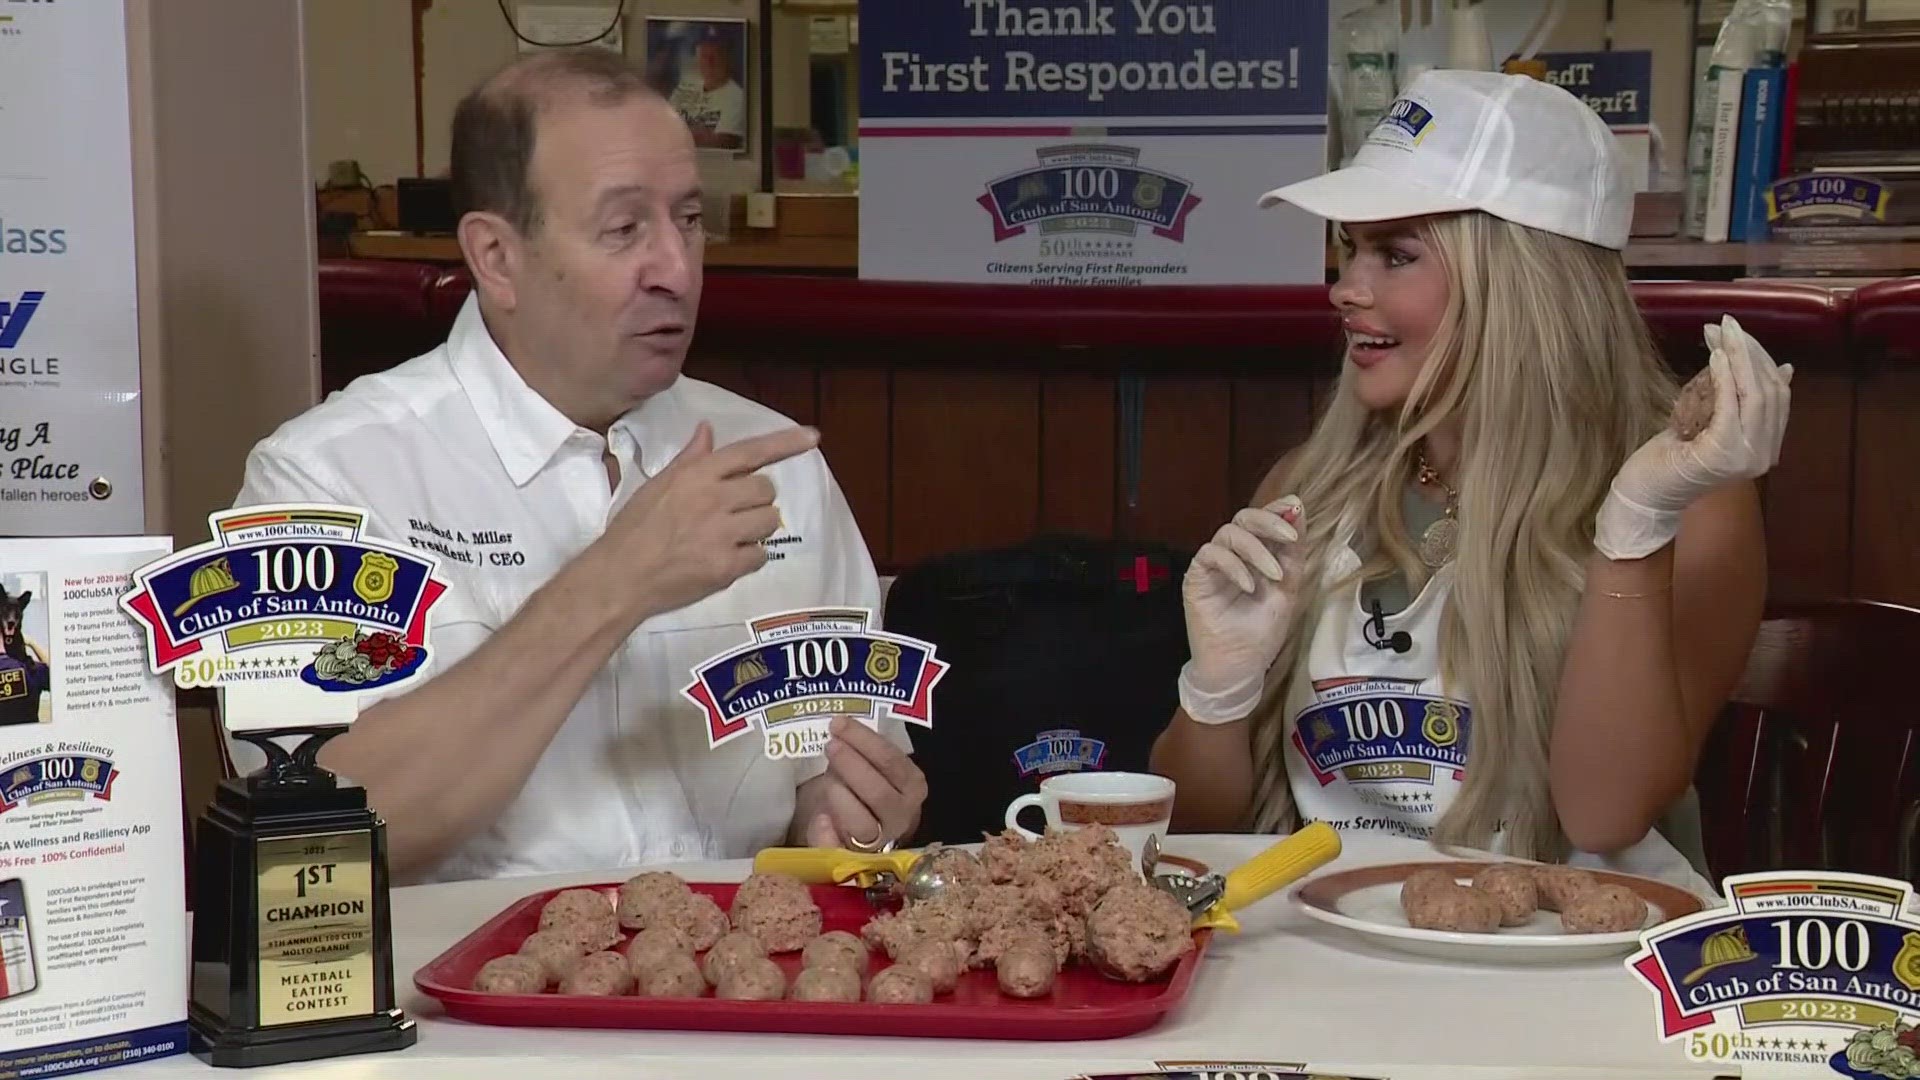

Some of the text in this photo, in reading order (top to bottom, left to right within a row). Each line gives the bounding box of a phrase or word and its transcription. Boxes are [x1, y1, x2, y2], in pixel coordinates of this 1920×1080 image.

[965, 0, 1216, 37] Thank You
[882, 48, 1299, 101] First Responders!
[1062, 168, 1119, 199] 100
[1811, 179, 1846, 195] 100
[1010, 199, 1168, 224] Club of San Antonio
[986, 262, 1188, 276] Citizens Serving First Responders
[26, 421, 51, 447] A
[11, 456, 80, 480] Place
[1, 488, 89, 502] fallen heroes
[471, 531, 513, 545] Miller
[408, 536, 473, 563] President
[489, 551, 525, 566] CEO
[250, 544, 335, 595] 100
[64, 578, 82, 586] New
[63, 587, 113, 600] 100ClubSA
[178, 594, 401, 635] Club of San Antonio
[77, 623, 101, 631] Trauma
[259, 621, 324, 640] 2023
[65, 637, 90, 645] Training
[180, 656, 235, 683] 50th
[780, 638, 849, 681] 100
[216, 668, 299, 682] ANNIVERSARY
[728, 679, 907, 716] Club of San Antonio
[792, 699, 844, 716] 2023
[1338, 699, 1404, 742] 100
[45, 741, 114, 758] & Resiliency
[768, 728, 819, 755] 50th
[1048, 739, 1073, 755] 100
[1316, 741, 1467, 767] Club of San Antonio
[39, 758, 75, 780] 100
[1358, 764, 1404, 777] 2023
[8, 786, 32, 800] Club
[33, 782, 44, 791] of
[44, 780, 63, 789] San
[65, 780, 102, 791] Antonio
[1352, 816, 1405, 832] Serving
[13, 824, 151, 850] Wellness and Resiliency App
[15, 843, 126, 867] Free 100% Confidential
[294, 864, 336, 898] 1ST
[266, 900, 364, 923] CHAMPION
[1771, 918, 1870, 971] 100
[281, 969, 352, 986] MEATBALL
[1689, 977, 1749, 1006] Club
[1755, 971, 1782, 993] of
[1788, 971, 1837, 991] San
[291, 984, 343, 998] EATING
[286, 996, 348, 1011] CONTEST
[1782, 1002, 1857, 1021] 2023
[1691, 1032, 1753, 1060] 50th
[1731, 1050, 1830, 1065] ANNIVERSARY
